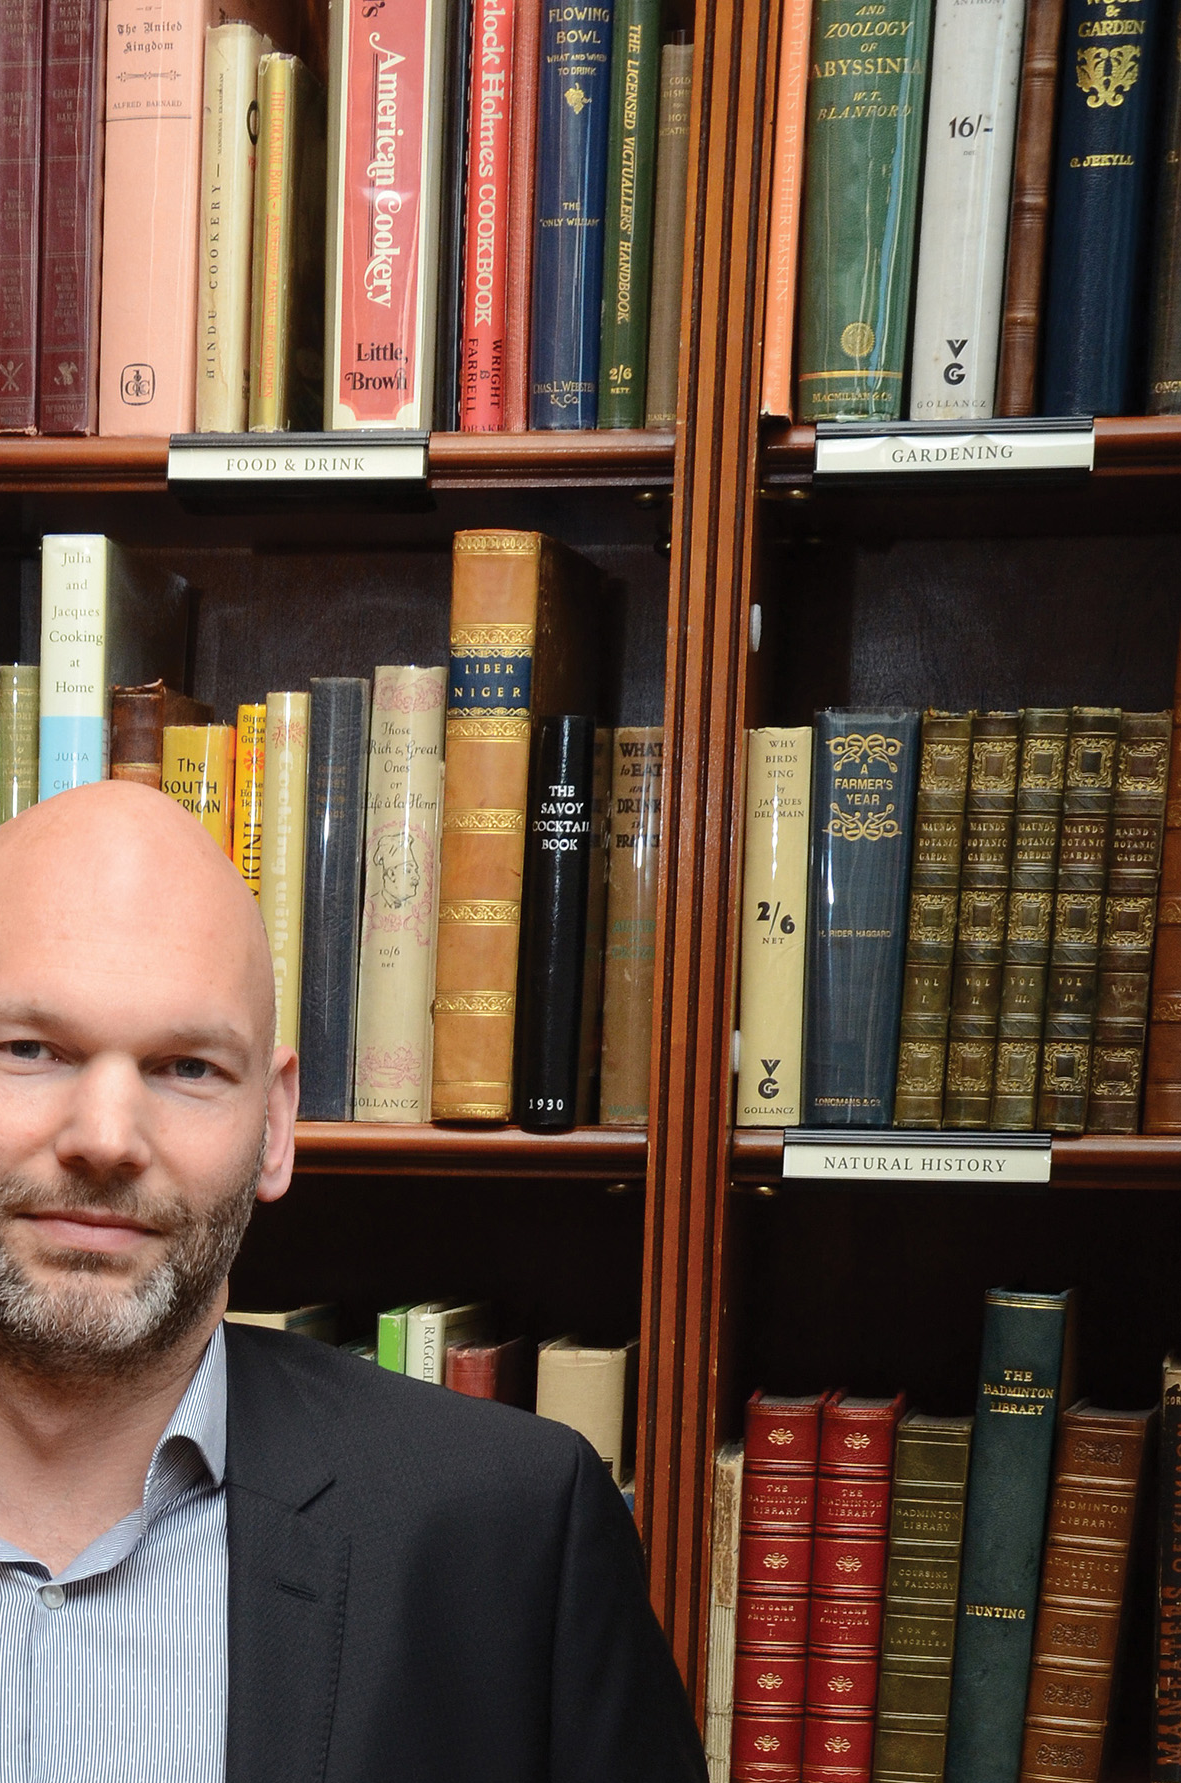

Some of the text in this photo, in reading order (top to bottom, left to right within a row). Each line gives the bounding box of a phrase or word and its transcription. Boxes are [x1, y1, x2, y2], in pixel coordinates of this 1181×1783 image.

[548, 7, 610, 24] FLOWING
[824, 22, 912, 38] ZOOLOGY
[1078, 20, 1145, 38] GARDEN
[556, 30, 601, 44] BOWL
[628, 23, 641, 54] THE
[123, 41, 174, 54] Kingdom
[861, 42, 877, 52] OF
[787, 34, 804, 109] PLANTS
[625, 59, 639, 130] LICENSED
[113, 99, 182, 110] ALFRED BARNARD
[817, 106, 912, 120] BLANFORD
[478, 71, 505, 177] Holmes
[785, 124, 797, 146] BY
[364, 32, 406, 308] American Cookery
[620, 136, 636, 232] VICTUALLERS'
[779, 152, 797, 232] ESTHER
[475, 187, 497, 327] COOKBOOK
[775, 238, 793, 302] BASKIN
[207, 184, 221, 379] HINDU COOKERY
[345, 370, 408, 391] Brown
[466, 338, 478, 415] FARRELL
[490, 339, 503, 409] WRIGHT
[609, 366, 632, 384] 2/6
[892, 444, 1014, 464] GARDENING
[226, 458, 365, 471] FOOD & DRINK
[61, 552, 92, 567] Julia
[65, 580, 88, 590] and
[52, 605, 100, 620] Jacques
[49, 630, 103, 646] Cooking
[69, 659, 80, 668] at
[465, 664, 514, 674] LIBER
[55, 682, 94, 693] Home
[454, 687, 520, 697] NIGER
[381, 722, 412, 736] Those
[619, 743, 663, 757] WHAT
[769, 740, 796, 748] WHY
[55, 753, 89, 761] JULIA
[765, 755, 798, 763] BIRDS
[178, 758, 207, 773] The
[384, 761, 410, 773] Ones
[860, 764, 868, 774] A
[767, 770, 794, 778] SING
[164, 781, 217, 794] SOUTH
[549, 785, 575, 797] THE
[835, 778, 894, 790] FARMER'S
[846, 794, 880, 805] YEAR
[541, 803, 584, 814] SAVOY
[532, 820, 589, 832] COCKTAIL
[542, 839, 578, 850] BOOK
[967, 838, 1008, 847] BOTANIC
[968, 853, 1004, 861] GARDEN
[756, 901, 795, 935] 2/6
[529, 1099, 565, 1111] 1930
[743, 1105, 795, 1115] GOLLANCZ
[823, 1155, 1007, 1173] NATURAL HISTORY
[1004, 1370, 1033, 1382] THE
[983, 1383, 1054, 1399] BADMINTON
[990, 1400, 1045, 1415] LIBRARY
[753, 1506, 800, 1516] LIBRARY
[896, 1509, 959, 1520] BADMINTON
[899, 1569, 948, 1579] COURSING
[965, 1604, 1026, 1619] HUNTING
